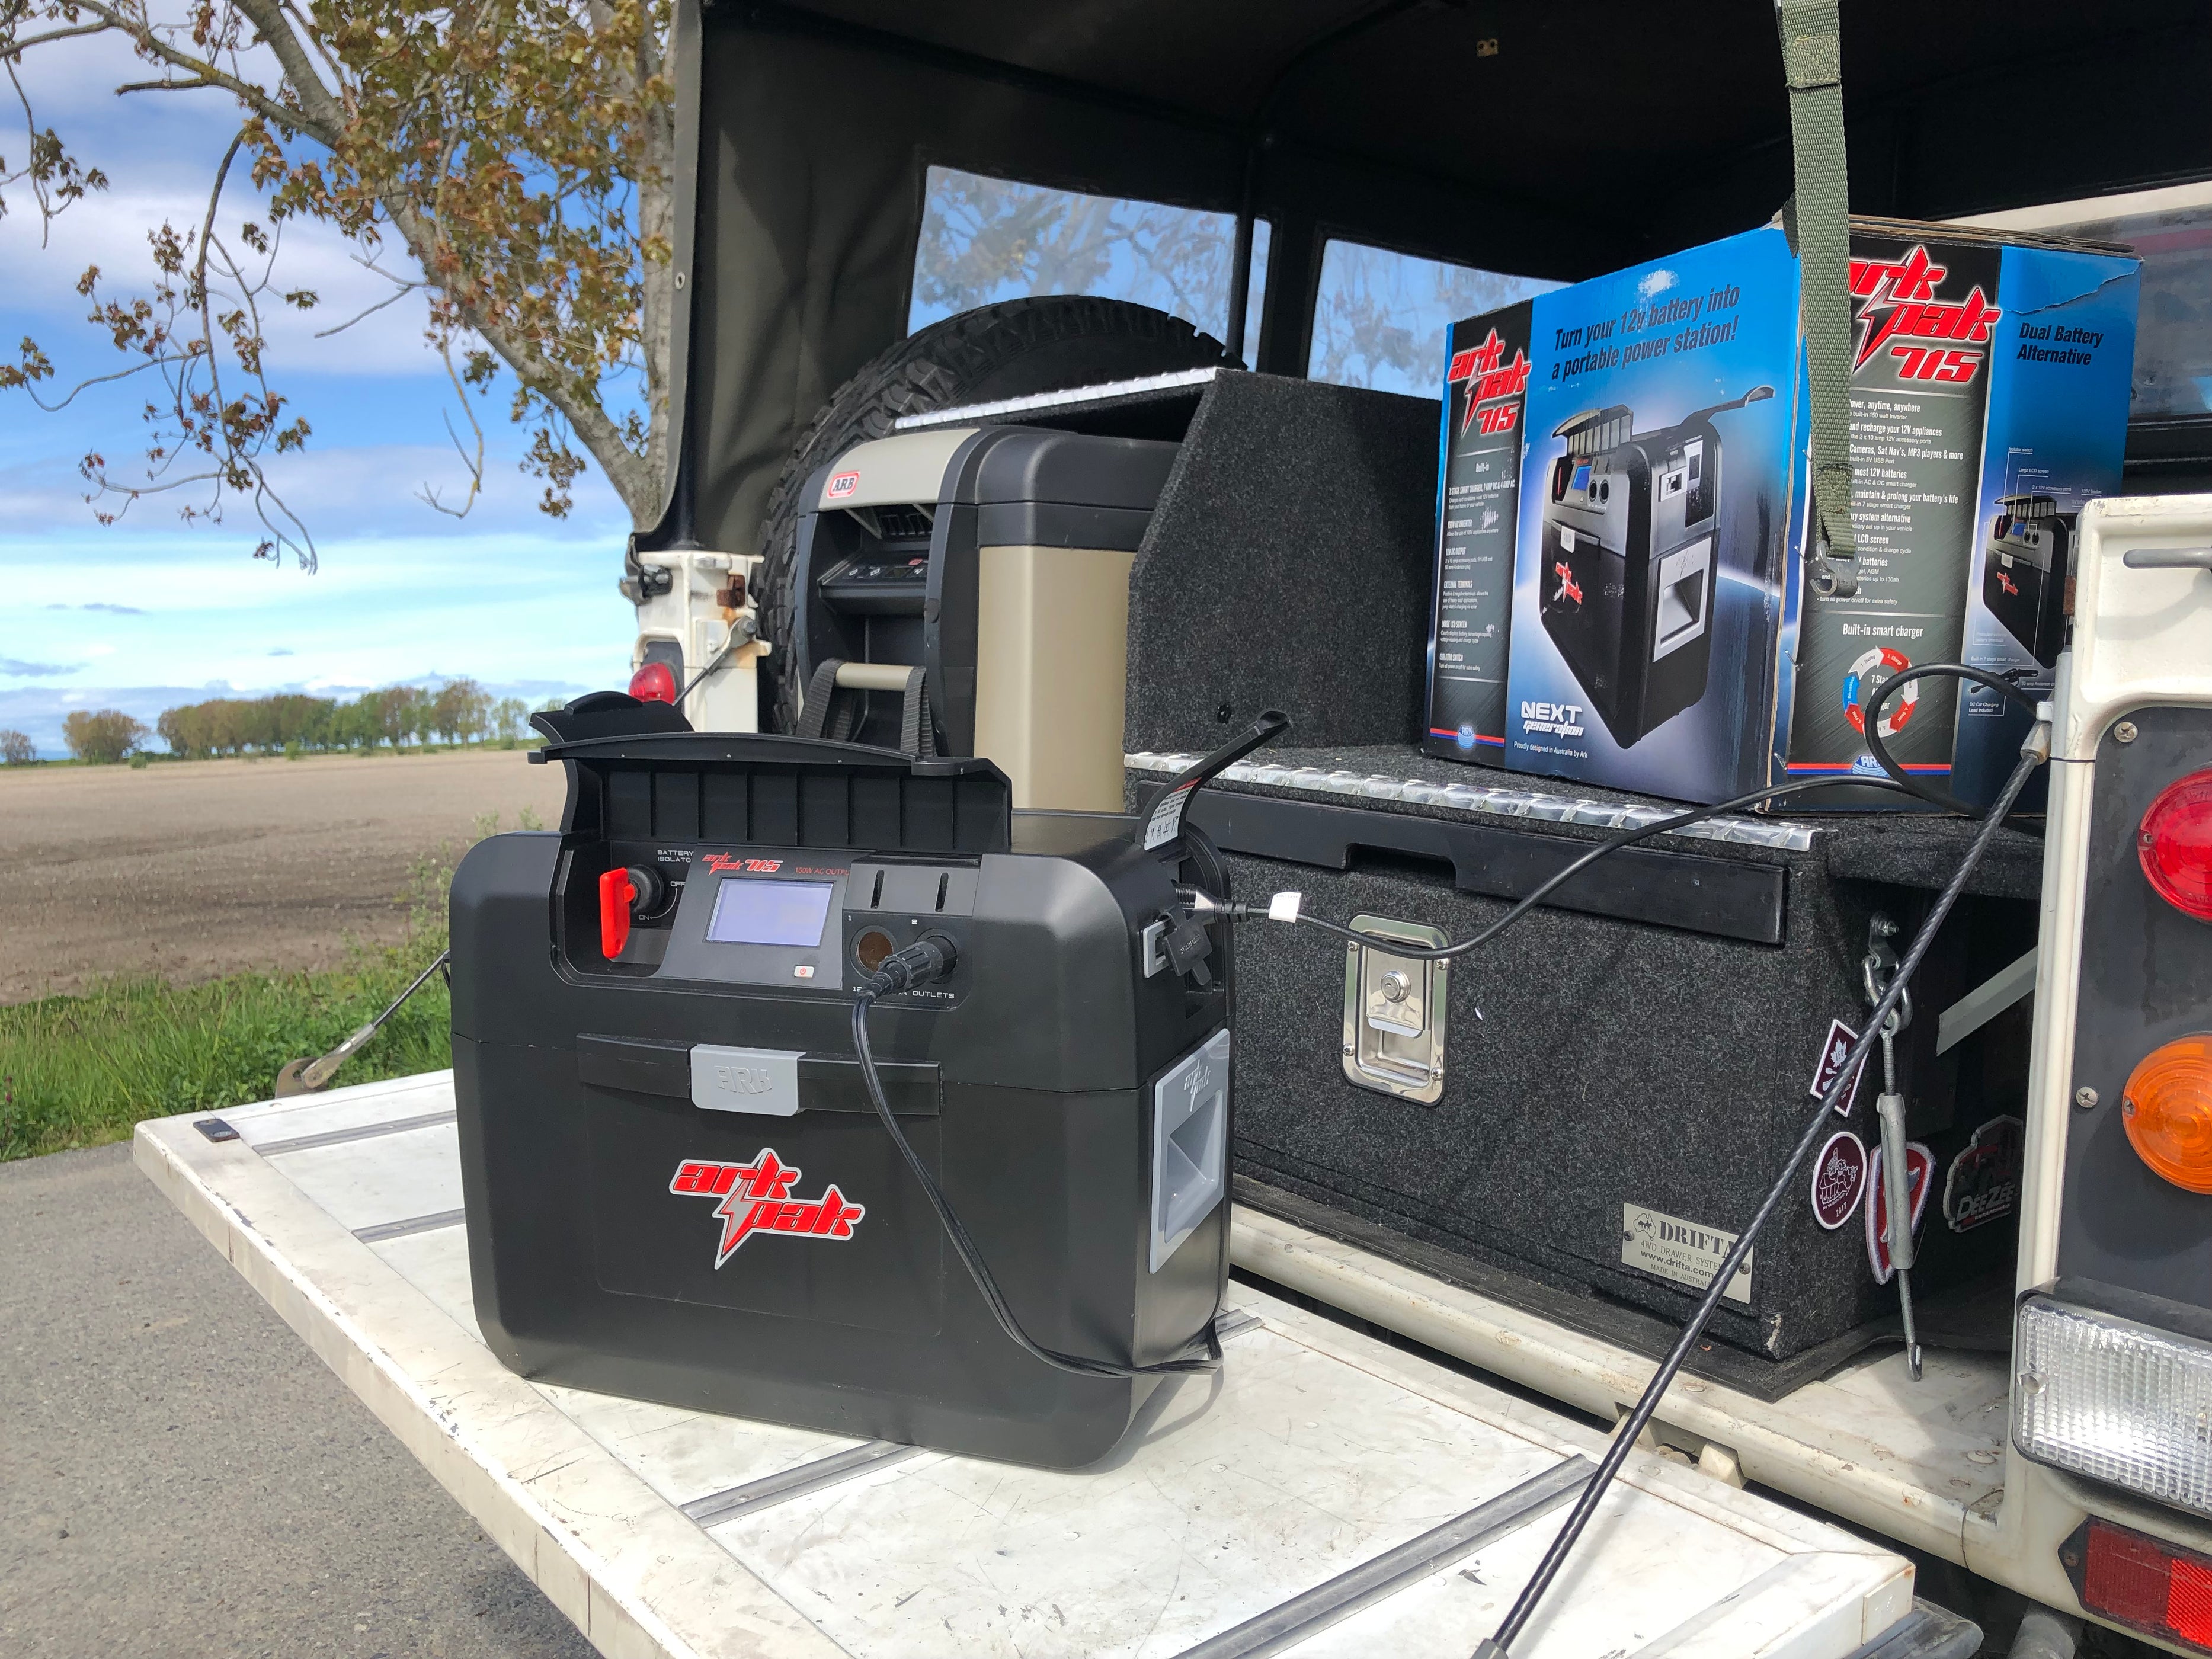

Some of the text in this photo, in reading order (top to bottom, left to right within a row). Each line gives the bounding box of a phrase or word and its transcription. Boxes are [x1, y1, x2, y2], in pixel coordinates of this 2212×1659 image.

[1555, 284, 1740, 351] Turn your 12v battery into
[1891, 287, 2001, 341] pak
[2020, 323, 2104, 348] Dual Battery
[1448, 328, 1504, 382] ark
[1551, 315, 1739, 383] a portable power station!
[2017, 344, 2092, 366] Alternative
[1891, 347, 1983, 382] 715
[1479, 348, 1531, 401] pak
[1849, 399, 1920, 412] ower, anytime, anywhere
[1477, 403, 1520, 435] 715
[1849, 422, 1942, 436] and recharge your 12V appliances
[1850, 444, 1963, 460] Cameras, Sat Nav's, MP3 players & more
[1870, 468, 1880, 477] 12V
[1881, 469, 1907, 479] batteries
[833, 478, 854, 492] ARB
[1855, 490, 1958, 504] maintain & prolong your battery's life
[1859, 513, 1879, 521] system
[1881, 513, 1910, 523] alternative
[1858, 534, 1889, 545] LCD screen
[1863, 558, 1888, 566] batteries
[1843, 623, 1923, 639] Built-in smart charger
[1520, 700, 1583, 723] NEXT
[1461, 726, 1472, 736] ARK
[1523, 720, 1584, 739] generation
[1514, 741, 1529, 751] Proudly
[1530, 744, 1548, 753] designed
[1554, 747, 1573, 756] Australia
[1573, 750, 1579, 758] by
[1861, 756, 1880, 767] AR
[745, 860, 783, 872] 715
[714, 1066, 772, 1095] ARK
[673, 1151, 798, 1199] ark
[750, 1187, 862, 1237] pak
[1836, 1202, 1846, 1217] 2017
[1641, 1241, 1721, 1270] 4WD DRAWER SYSTE
[1651, 1264, 1668, 1274] MADE
[1681, 1274, 1710, 1287] AUSTRAL
